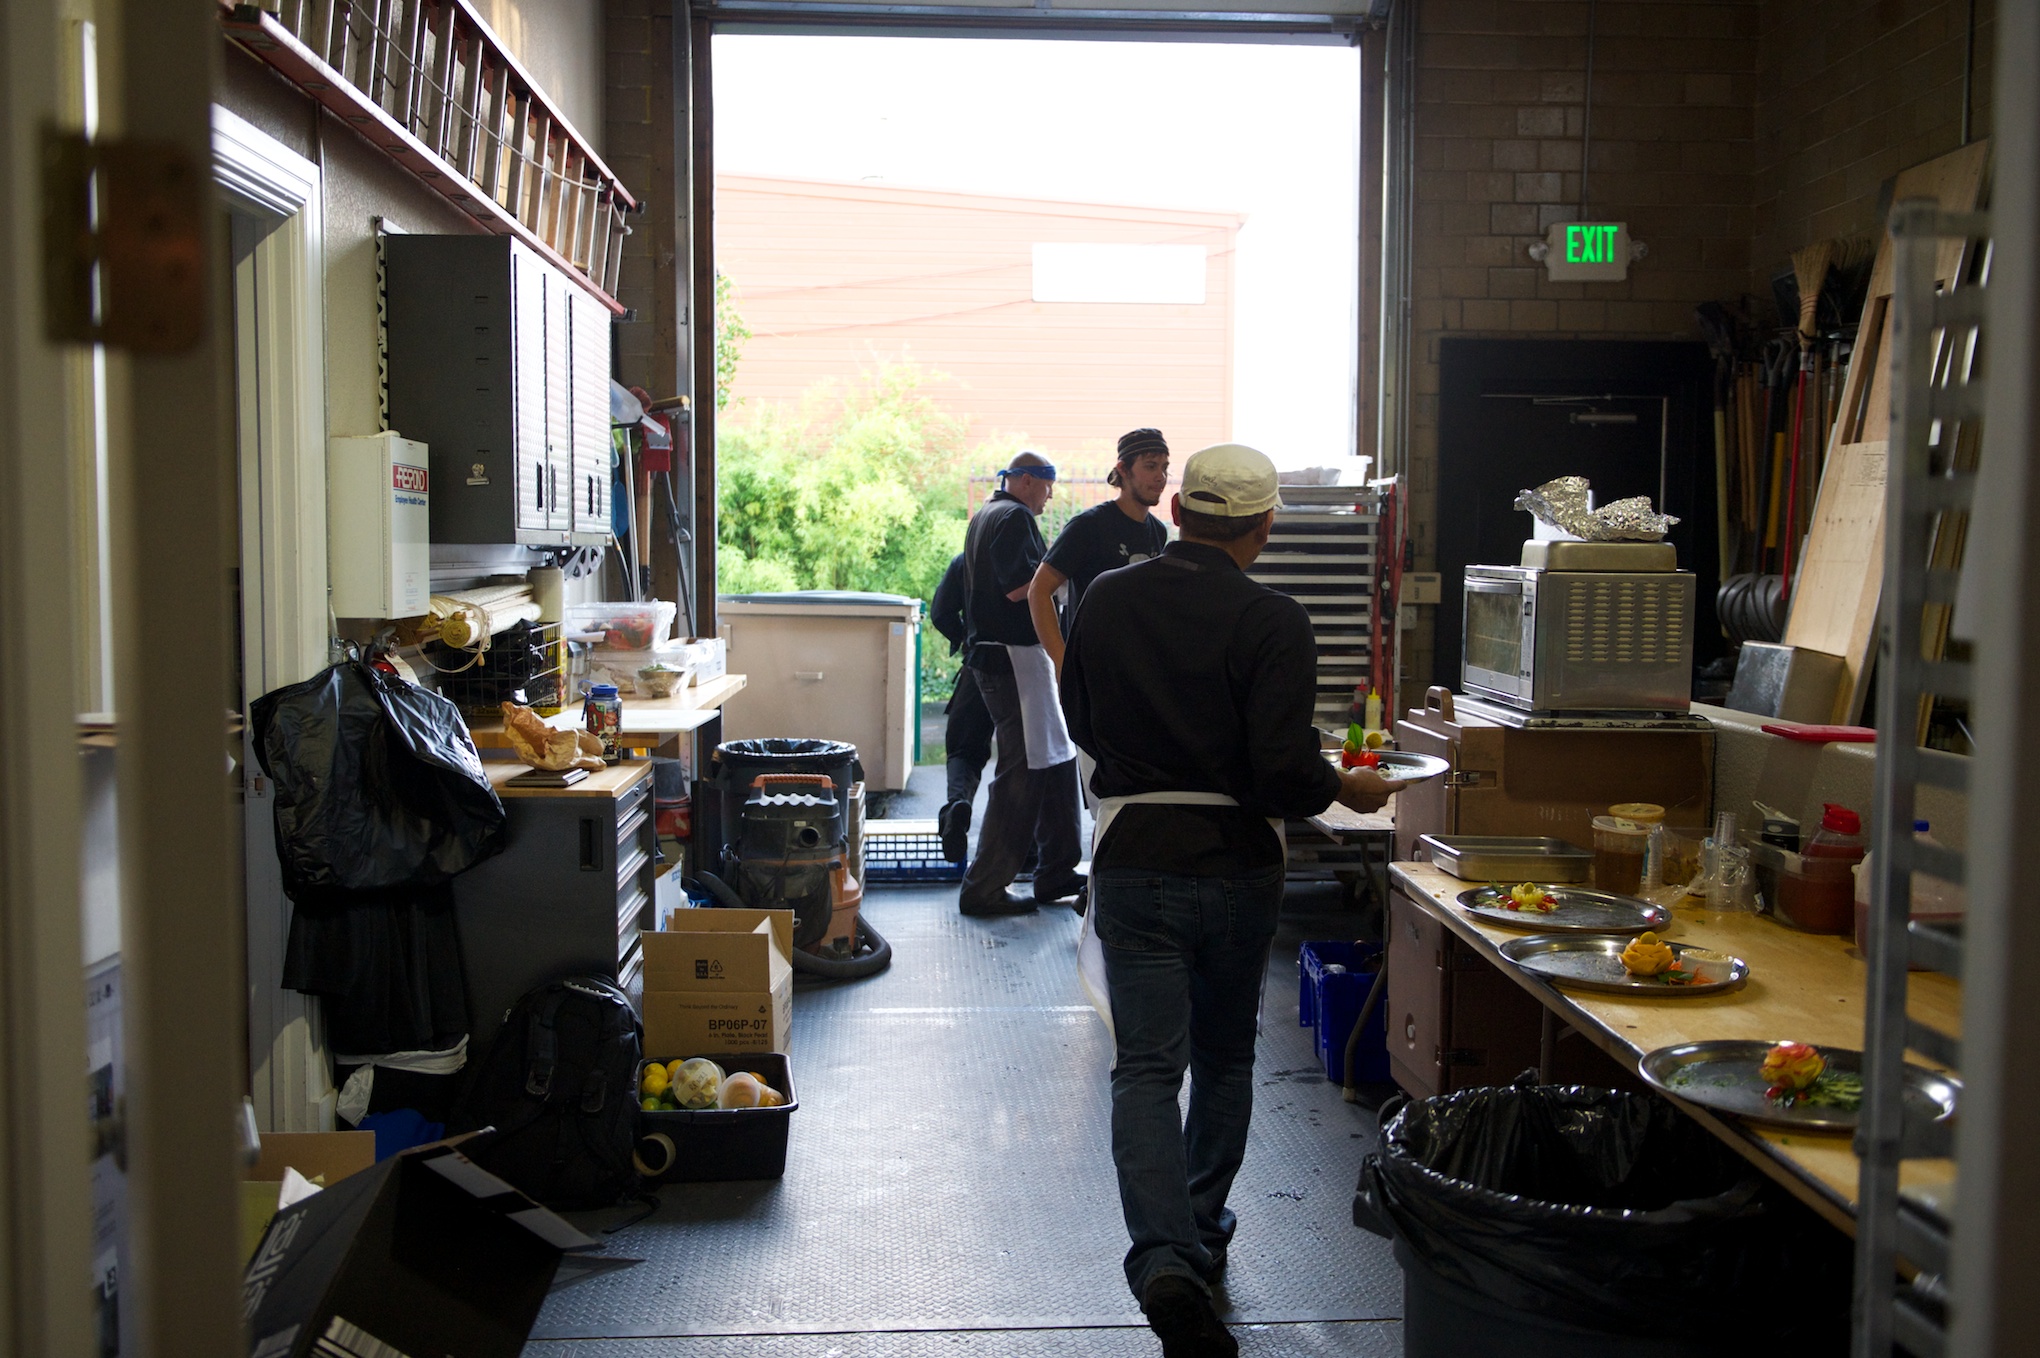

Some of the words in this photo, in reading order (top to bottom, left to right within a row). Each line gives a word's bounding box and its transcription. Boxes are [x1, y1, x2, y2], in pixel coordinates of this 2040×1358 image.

[1566, 225, 1618, 263] EXIT
[396, 467, 426, 490] RESPOND
[395, 494, 408, 505] Employee
[408, 496, 417, 504] Health
[418, 497, 426, 506] Center
[709, 1020, 767, 1030] BP06P-07
